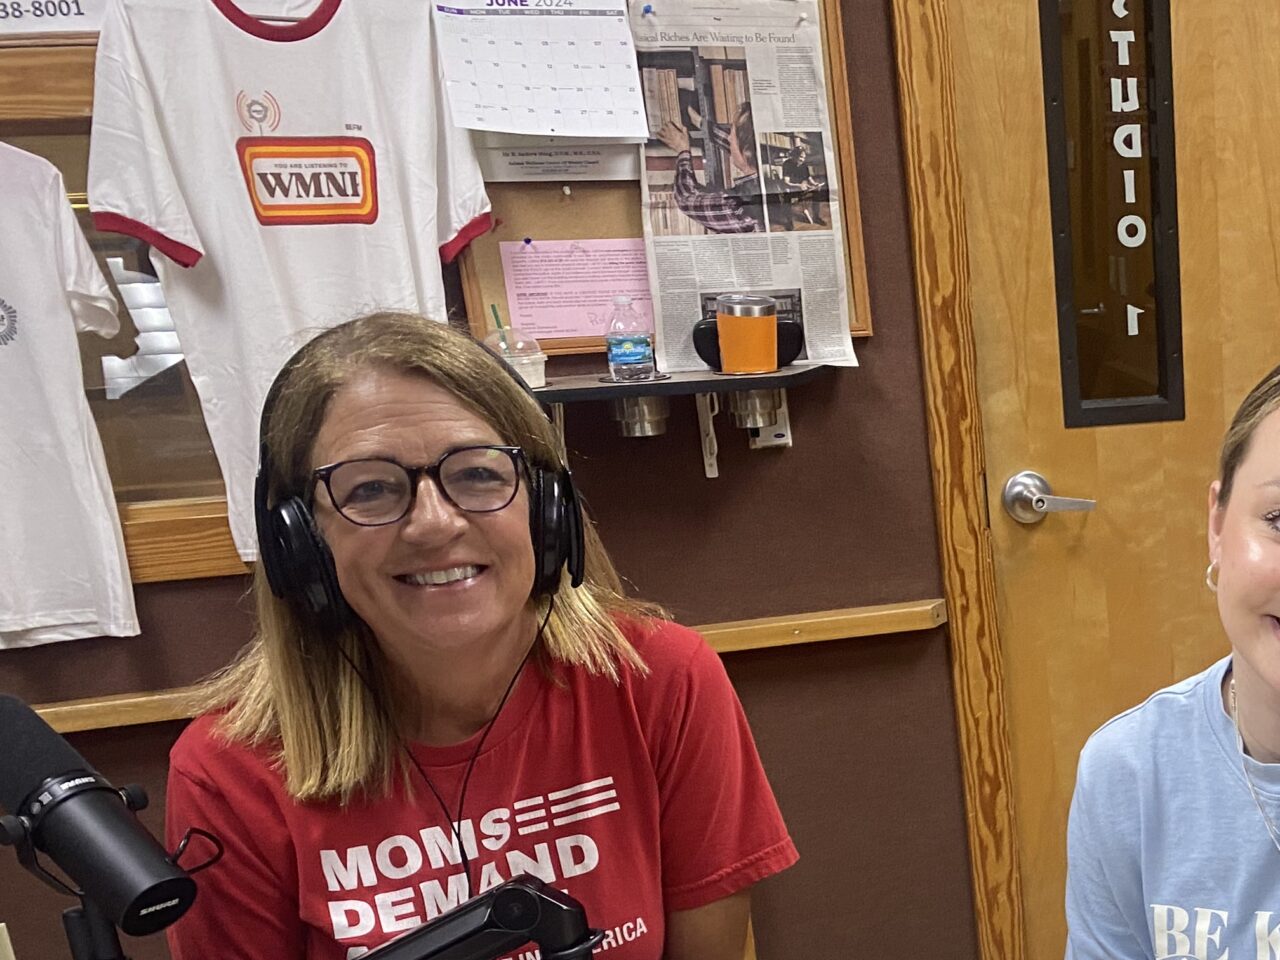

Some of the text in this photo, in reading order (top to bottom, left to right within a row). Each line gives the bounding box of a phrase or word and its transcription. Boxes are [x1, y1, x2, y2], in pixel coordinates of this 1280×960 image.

[659, 32, 689, 42] Riches
[692, 32, 709, 42] Are
[710, 32, 744, 45] Waiting
[745, 33, 753, 42] to
[755, 32, 768, 42] Be
[768, 33, 796, 43] Found
[320, 807, 511, 892] MOMS
[139, 898, 180, 916] SHURE
[328, 834, 600, 939] DEMAND
